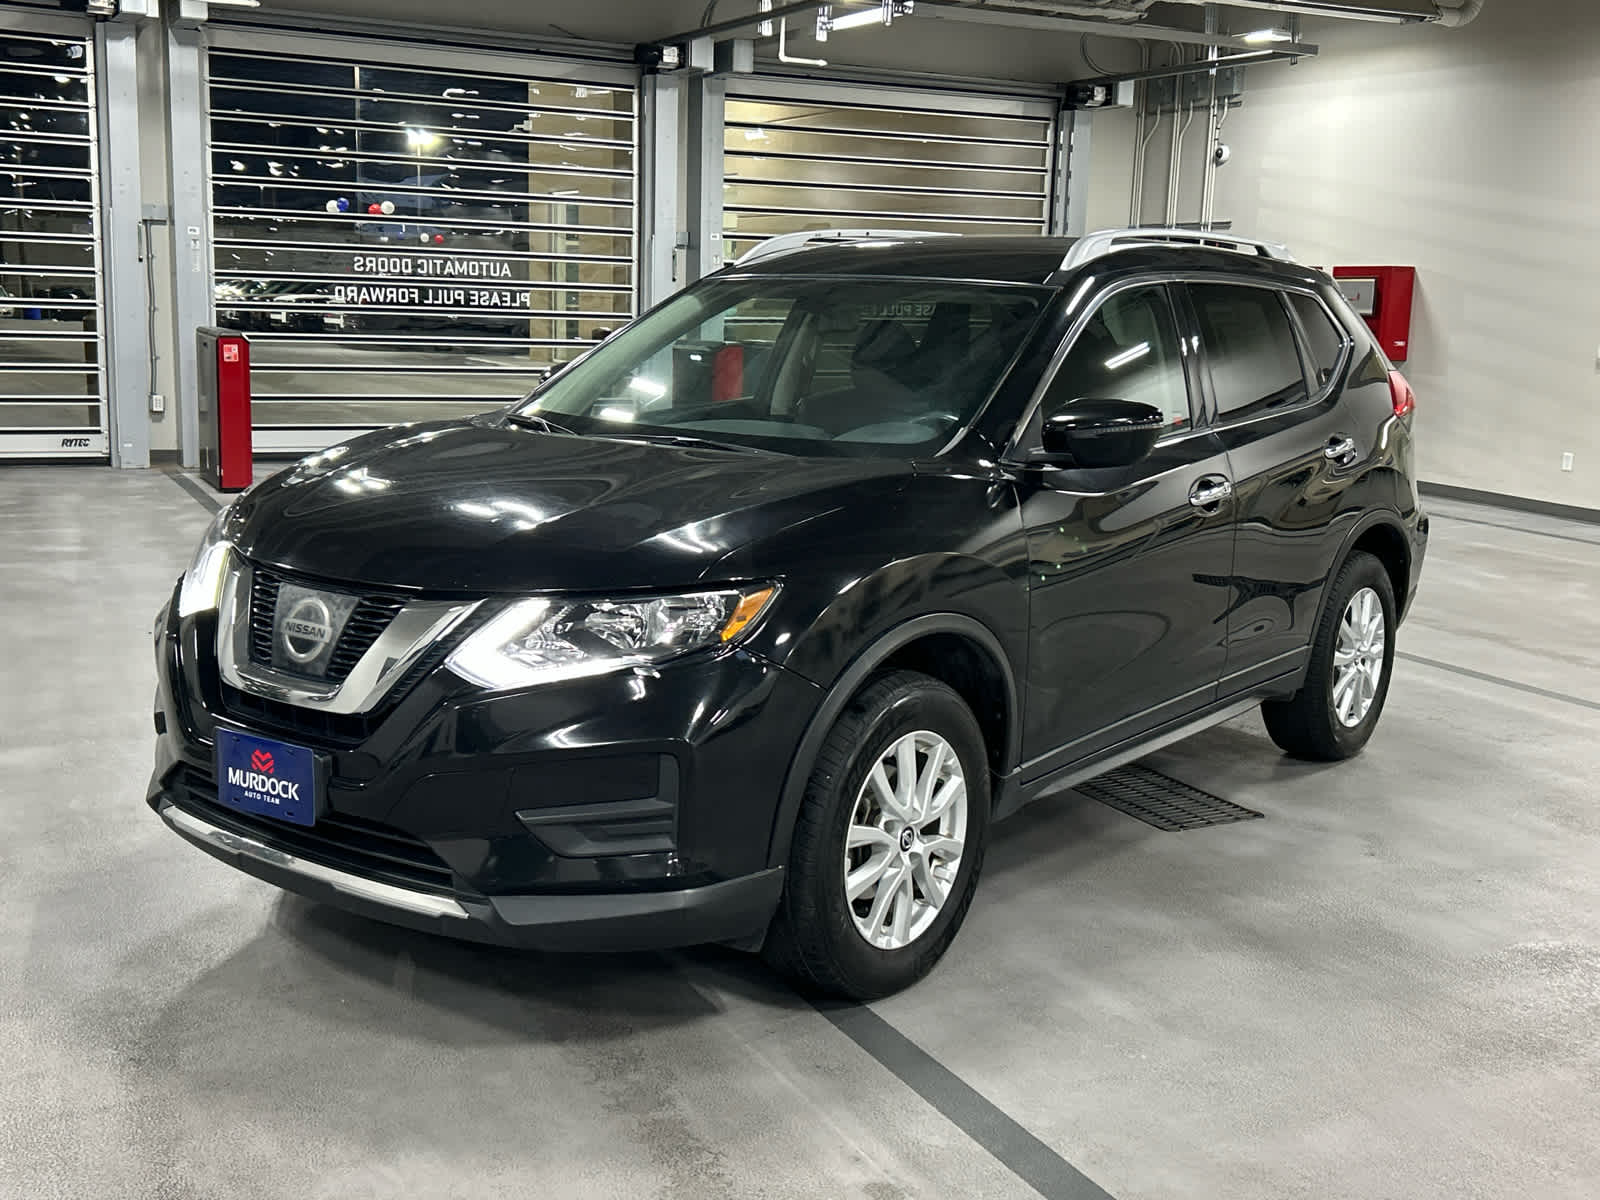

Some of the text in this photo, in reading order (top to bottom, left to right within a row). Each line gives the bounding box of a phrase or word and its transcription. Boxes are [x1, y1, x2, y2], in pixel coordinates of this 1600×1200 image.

[284, 621, 326, 639] NISSAN
[227, 766, 299, 801] MURDOCK
[244, 790, 280, 805] AUTO TEAM
